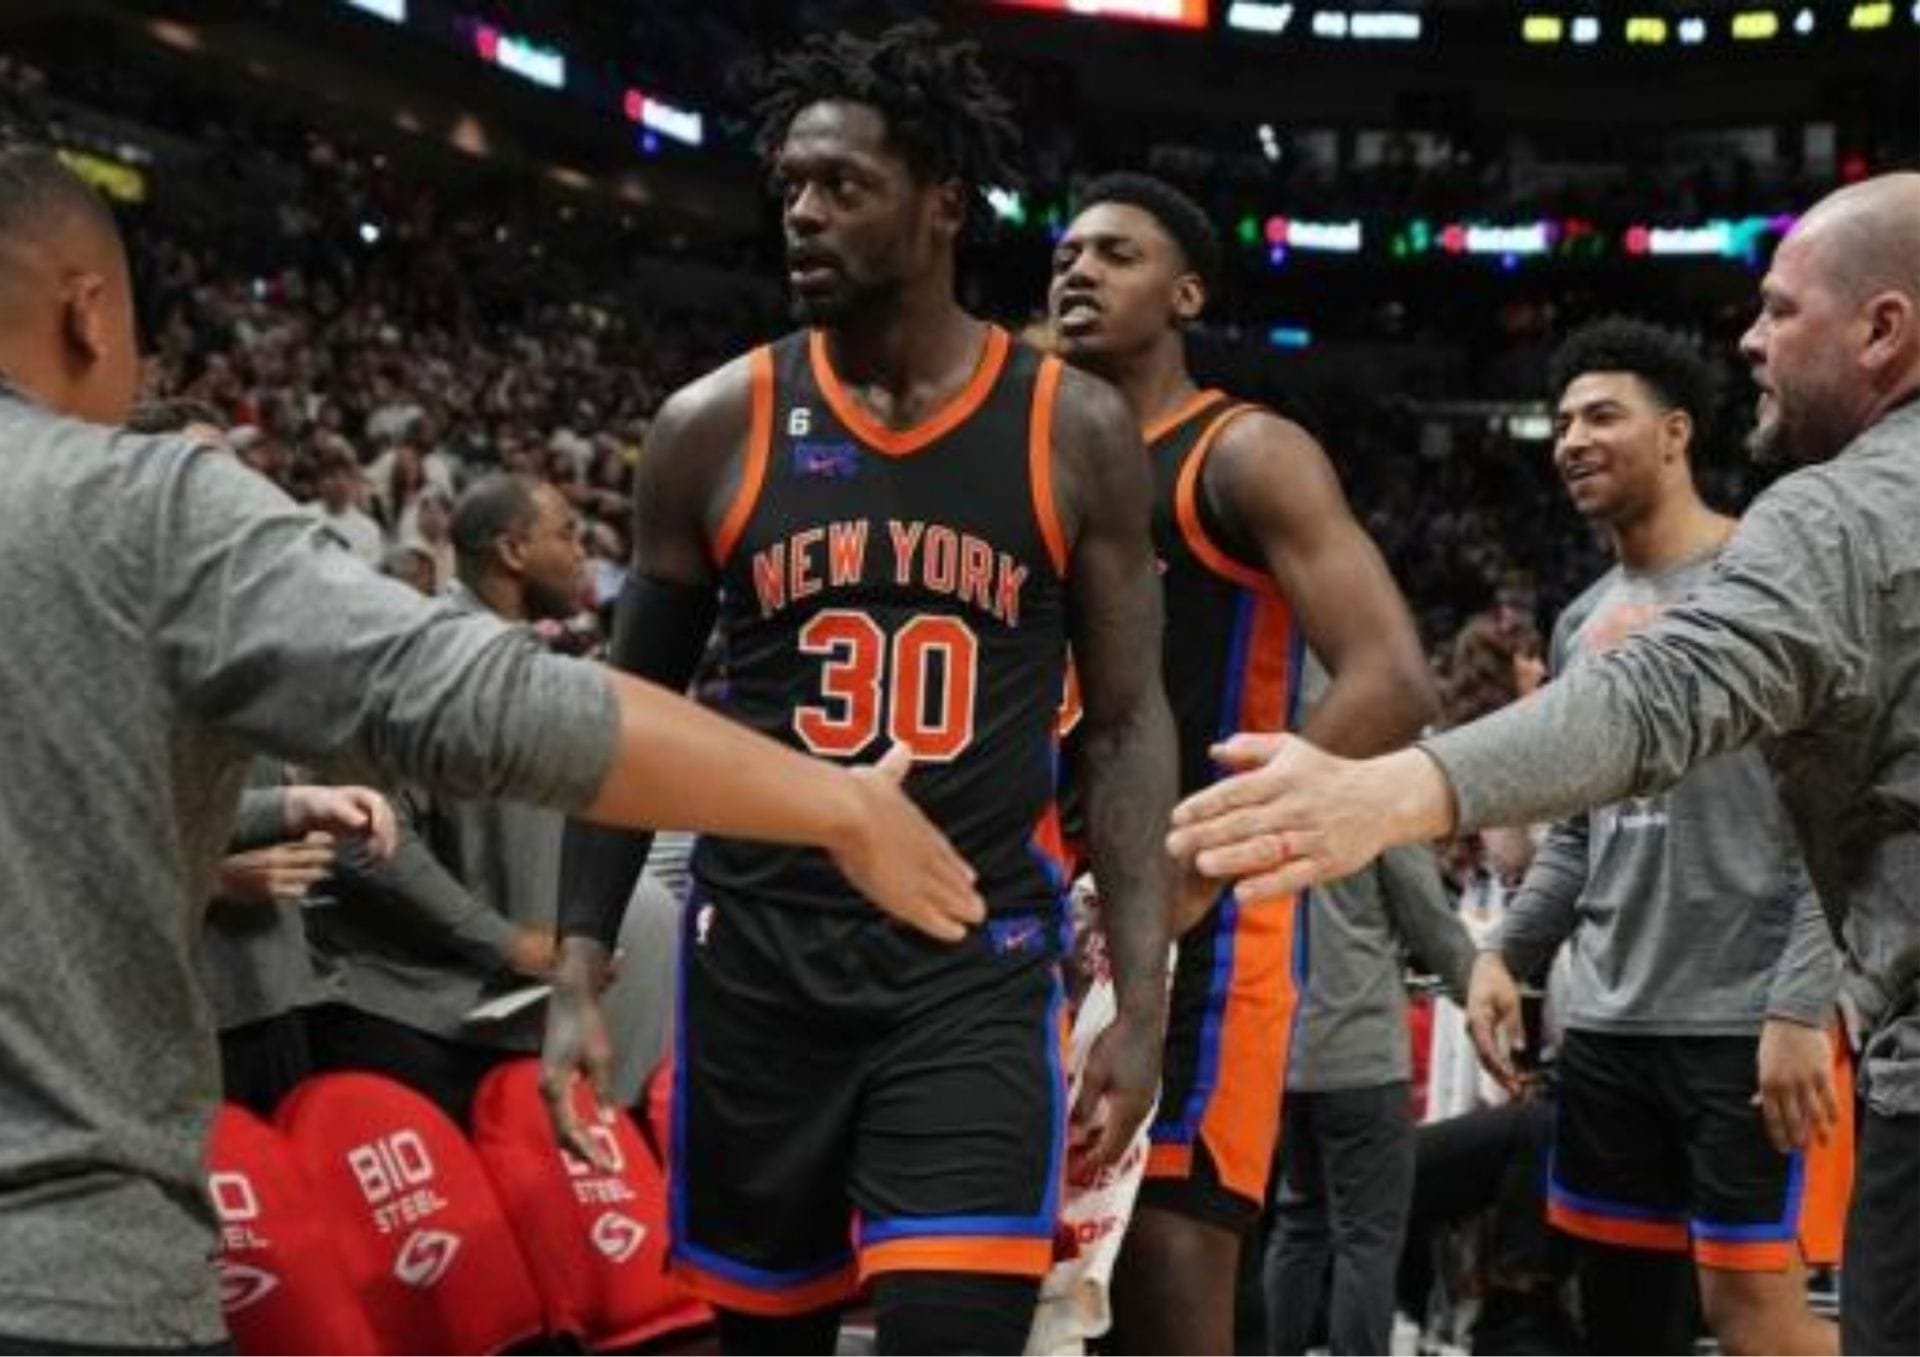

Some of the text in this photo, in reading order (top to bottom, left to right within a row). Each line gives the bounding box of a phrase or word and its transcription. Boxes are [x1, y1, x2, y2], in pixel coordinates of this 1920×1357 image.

[788, 406, 811, 436] 6
[753, 519, 1029, 628] NEW YORK
[794, 608, 977, 761] 30
[347, 1129, 434, 1203] BIO
[373, 1190, 449, 1233] STEEL
